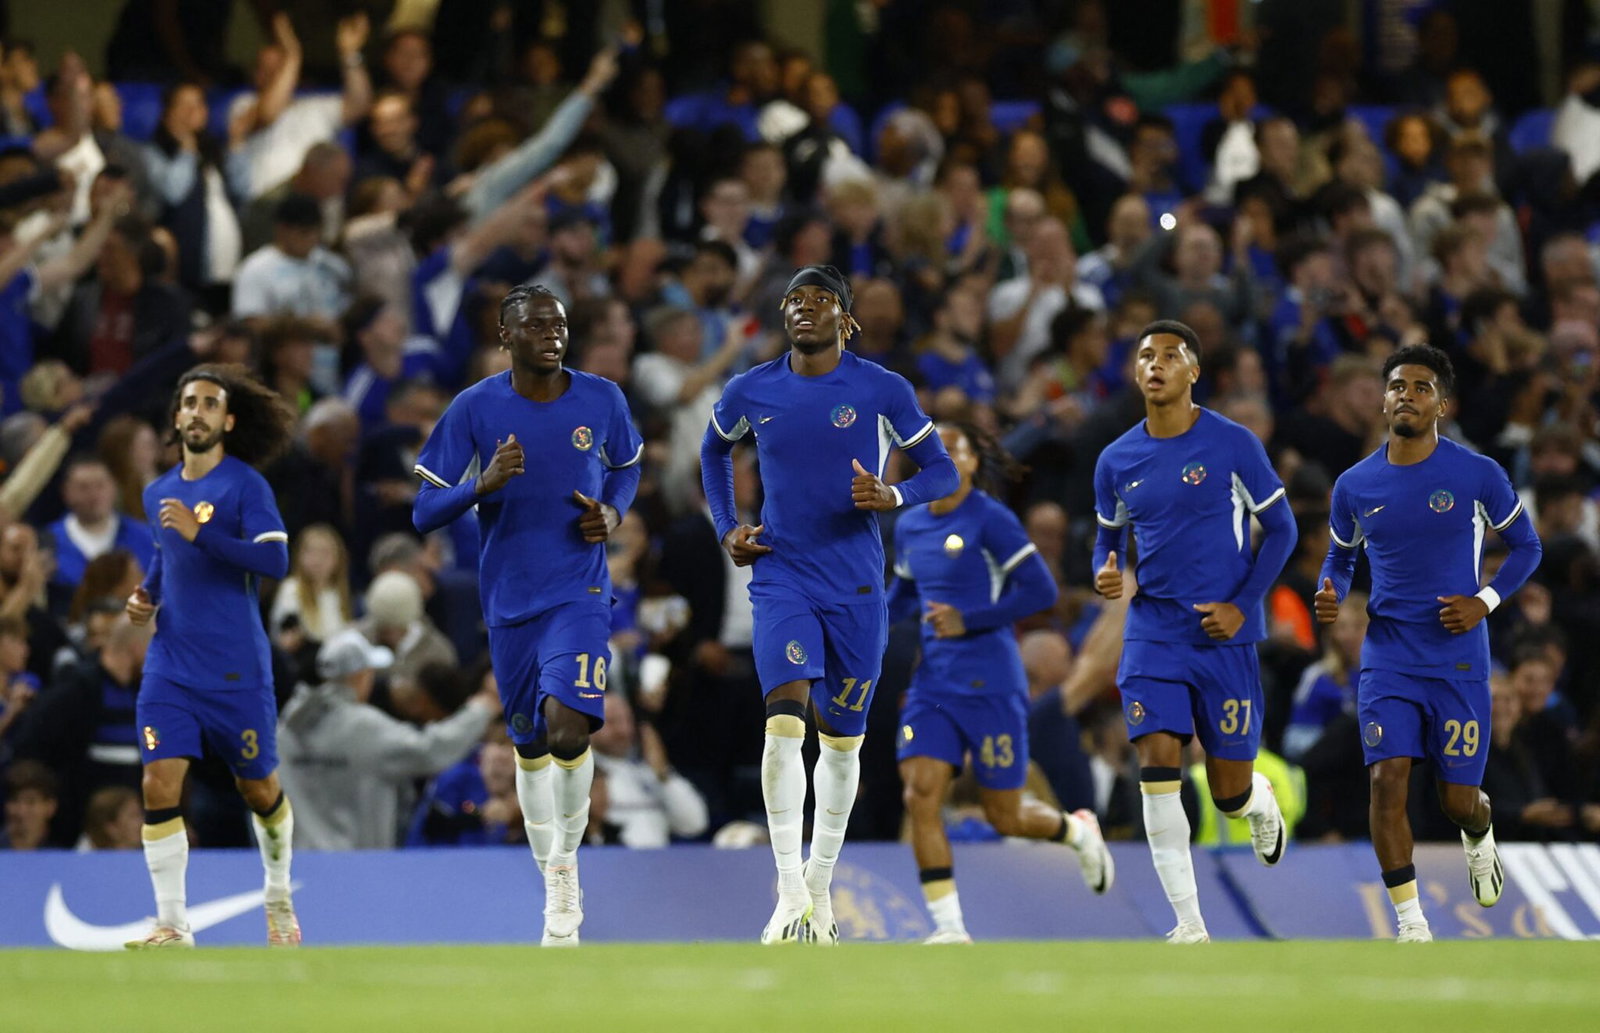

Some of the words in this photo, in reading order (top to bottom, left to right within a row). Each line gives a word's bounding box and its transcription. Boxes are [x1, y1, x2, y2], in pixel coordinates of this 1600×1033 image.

[575, 653, 606, 691] 16
[832, 678, 872, 712] 11
[1220, 698, 1251, 735] 37
[241, 729, 259, 760] 3
[980, 734, 1014, 768] 43
[1444, 719, 1479, 757] 29
